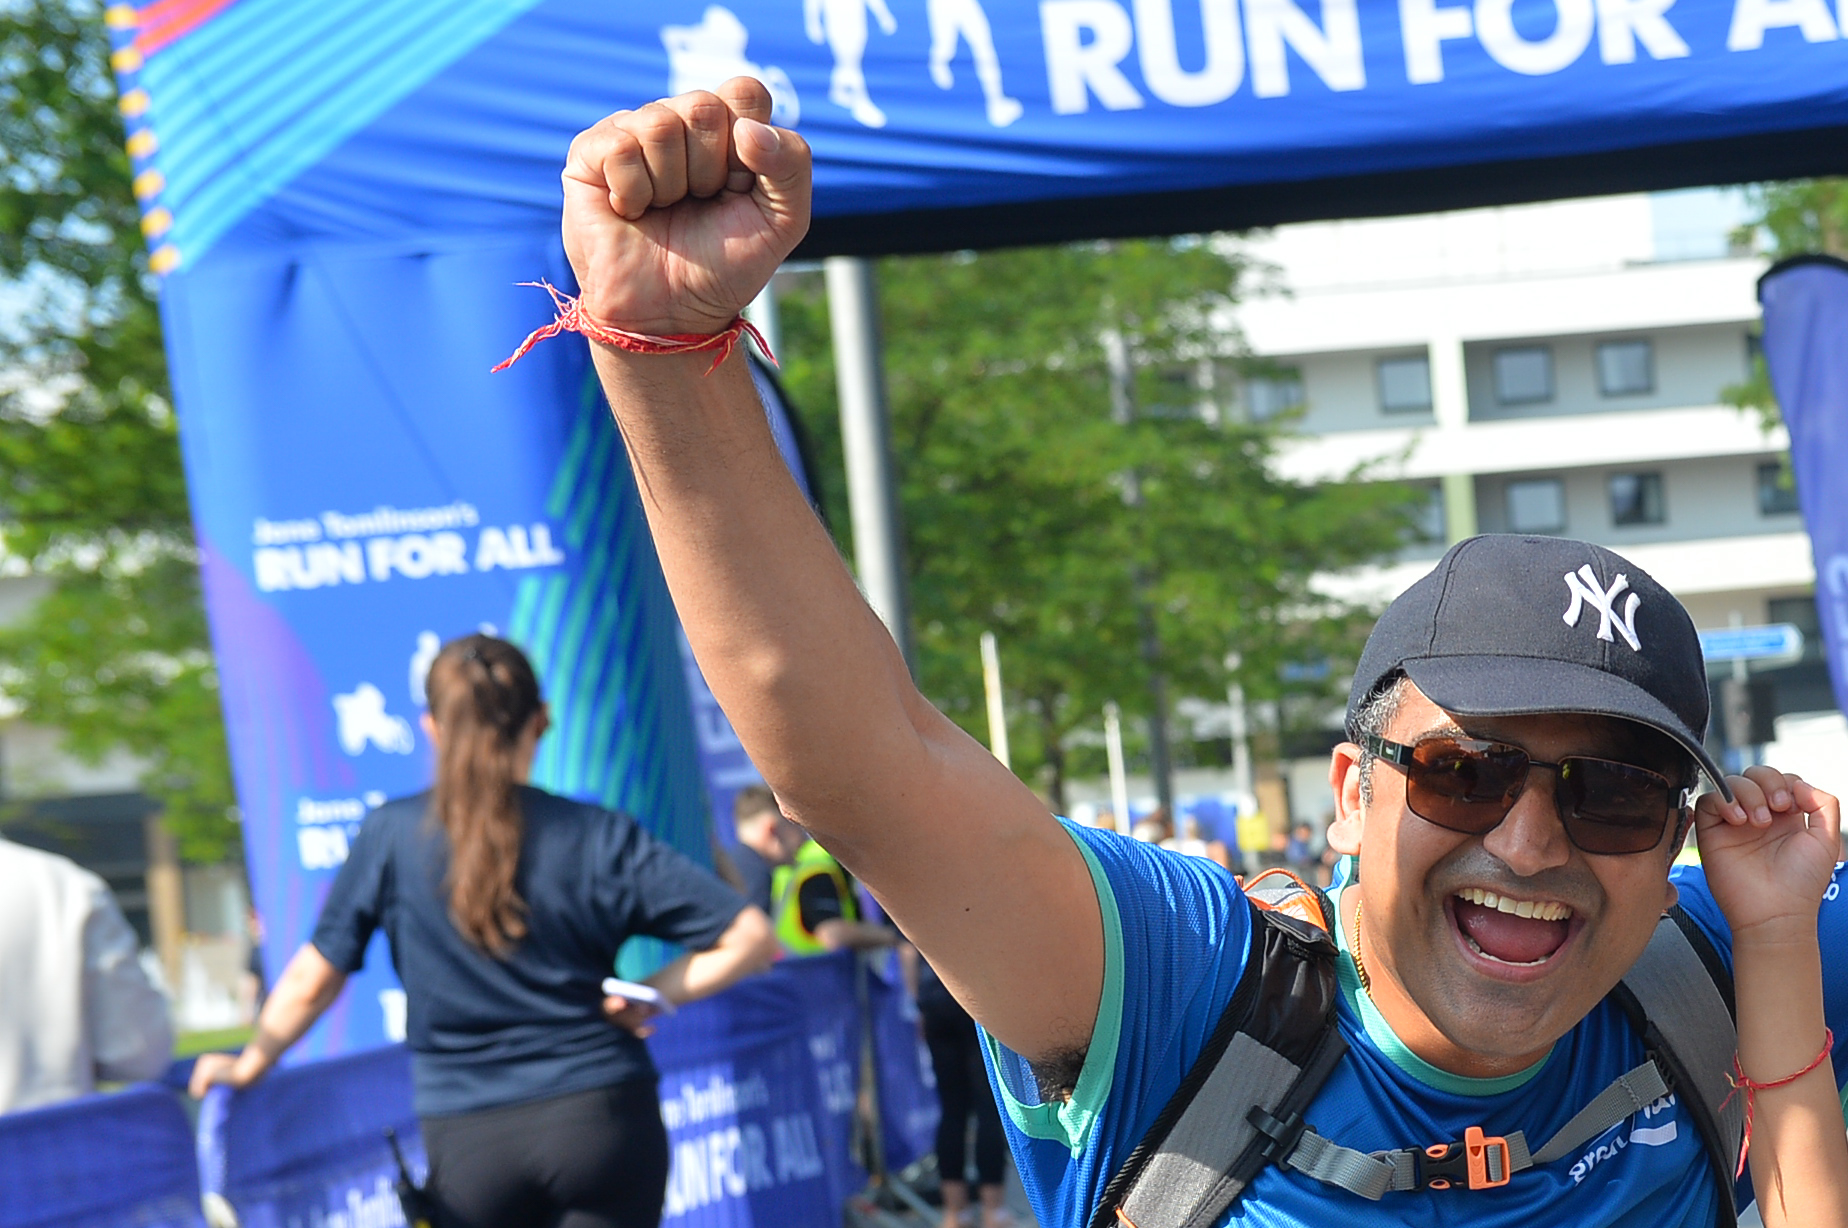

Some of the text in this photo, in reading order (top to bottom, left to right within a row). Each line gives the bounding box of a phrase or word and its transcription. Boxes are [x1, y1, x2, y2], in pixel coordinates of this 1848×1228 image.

[1040, 0, 1366, 115] RUN
[1402, 0, 1692, 85] FOR
[253, 523, 565, 592] RUN FOR ALL
[1562, 563, 1642, 652] NY
[708, 1126, 774, 1204] FOR
[771, 1112, 824, 1183] ALL
